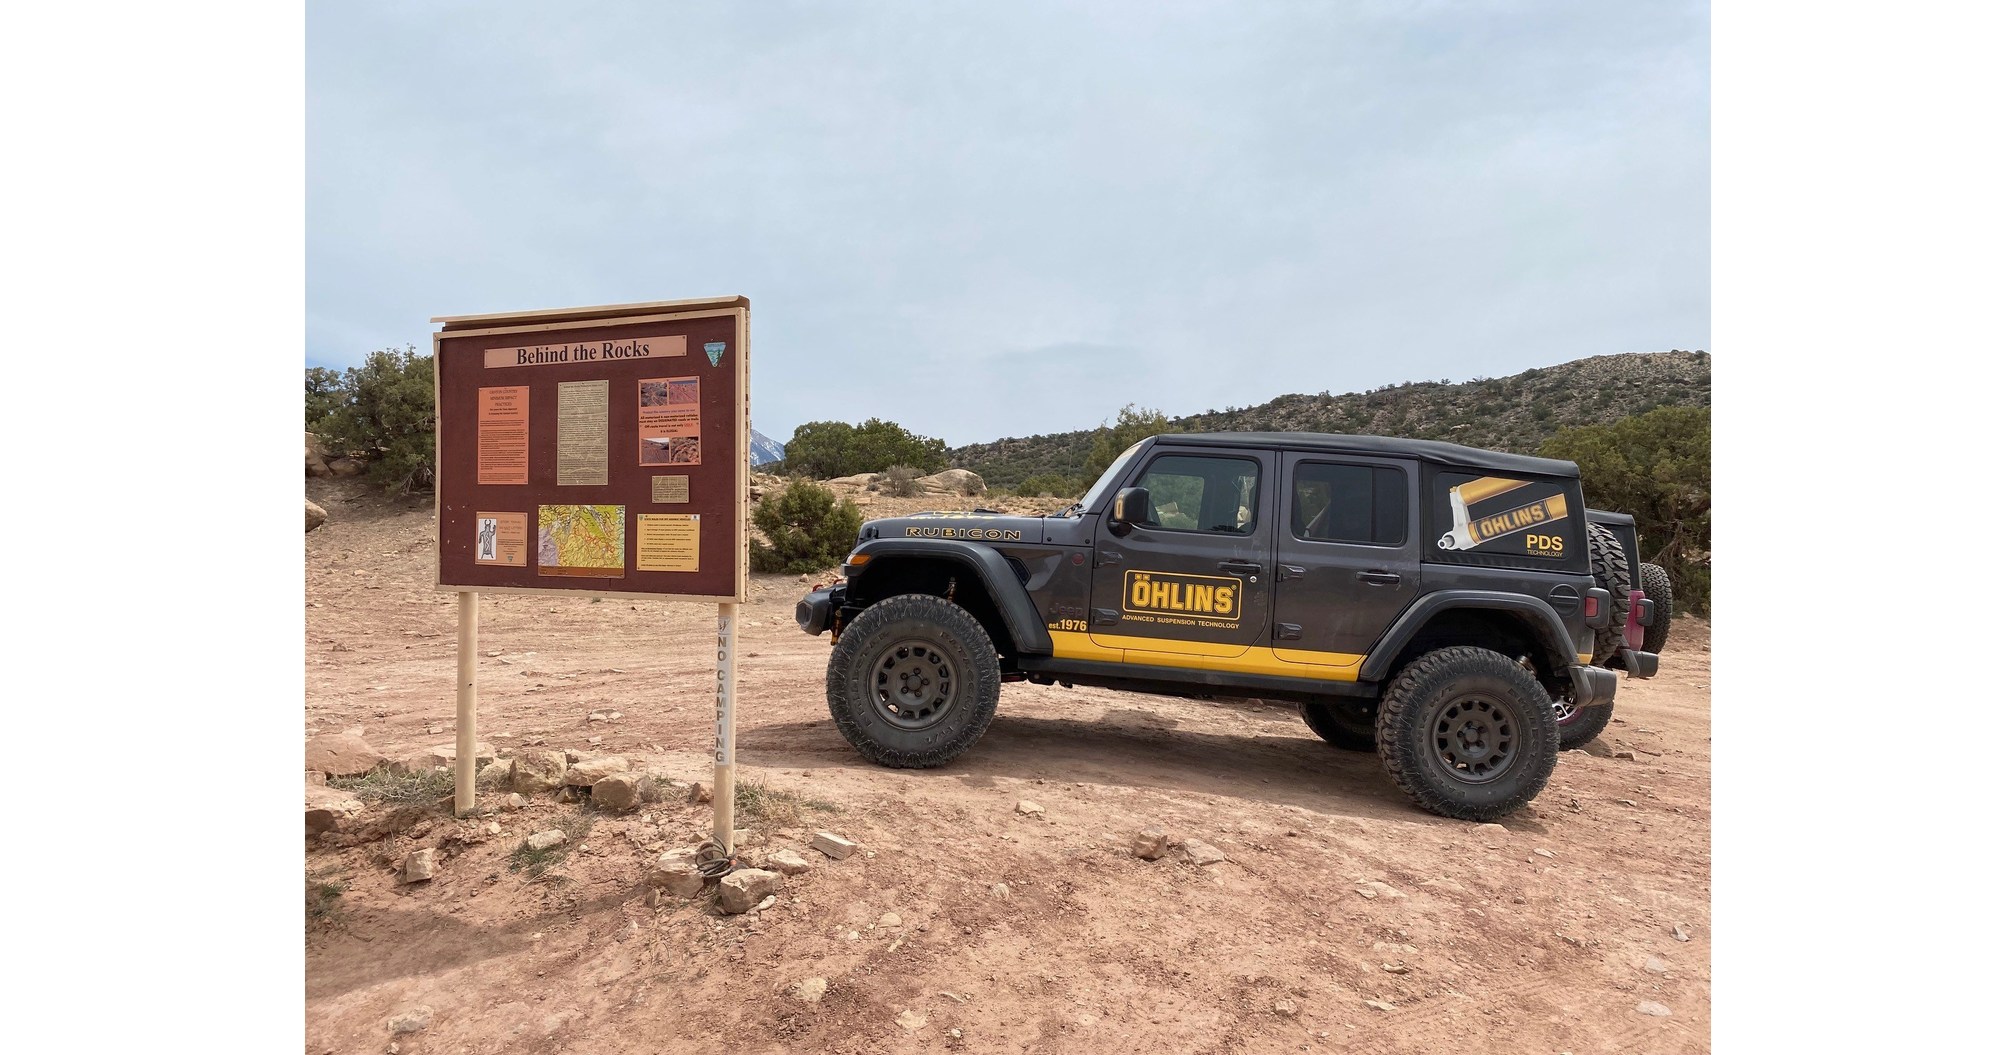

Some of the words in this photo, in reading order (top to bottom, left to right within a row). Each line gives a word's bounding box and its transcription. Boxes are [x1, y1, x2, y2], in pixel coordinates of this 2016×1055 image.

[516, 345, 569, 365] Behind
[573, 344, 597, 361] the
[601, 340, 650, 360] Rocks
[905, 527, 1021, 541] RUBICON
[1526, 534, 1564, 551] PDS
[1527, 549, 1563, 557] TECHNOLOGY
[1131, 573, 1234, 614] ÖHLINS
[1121, 614, 1155, 623] ADVANCED
[1156, 617, 1196, 626] SUSPENSION
[1197, 620, 1240, 630] TECHNOLOGY
[717, 636, 727, 662] NO
[715, 669, 727, 763] CAMPING
